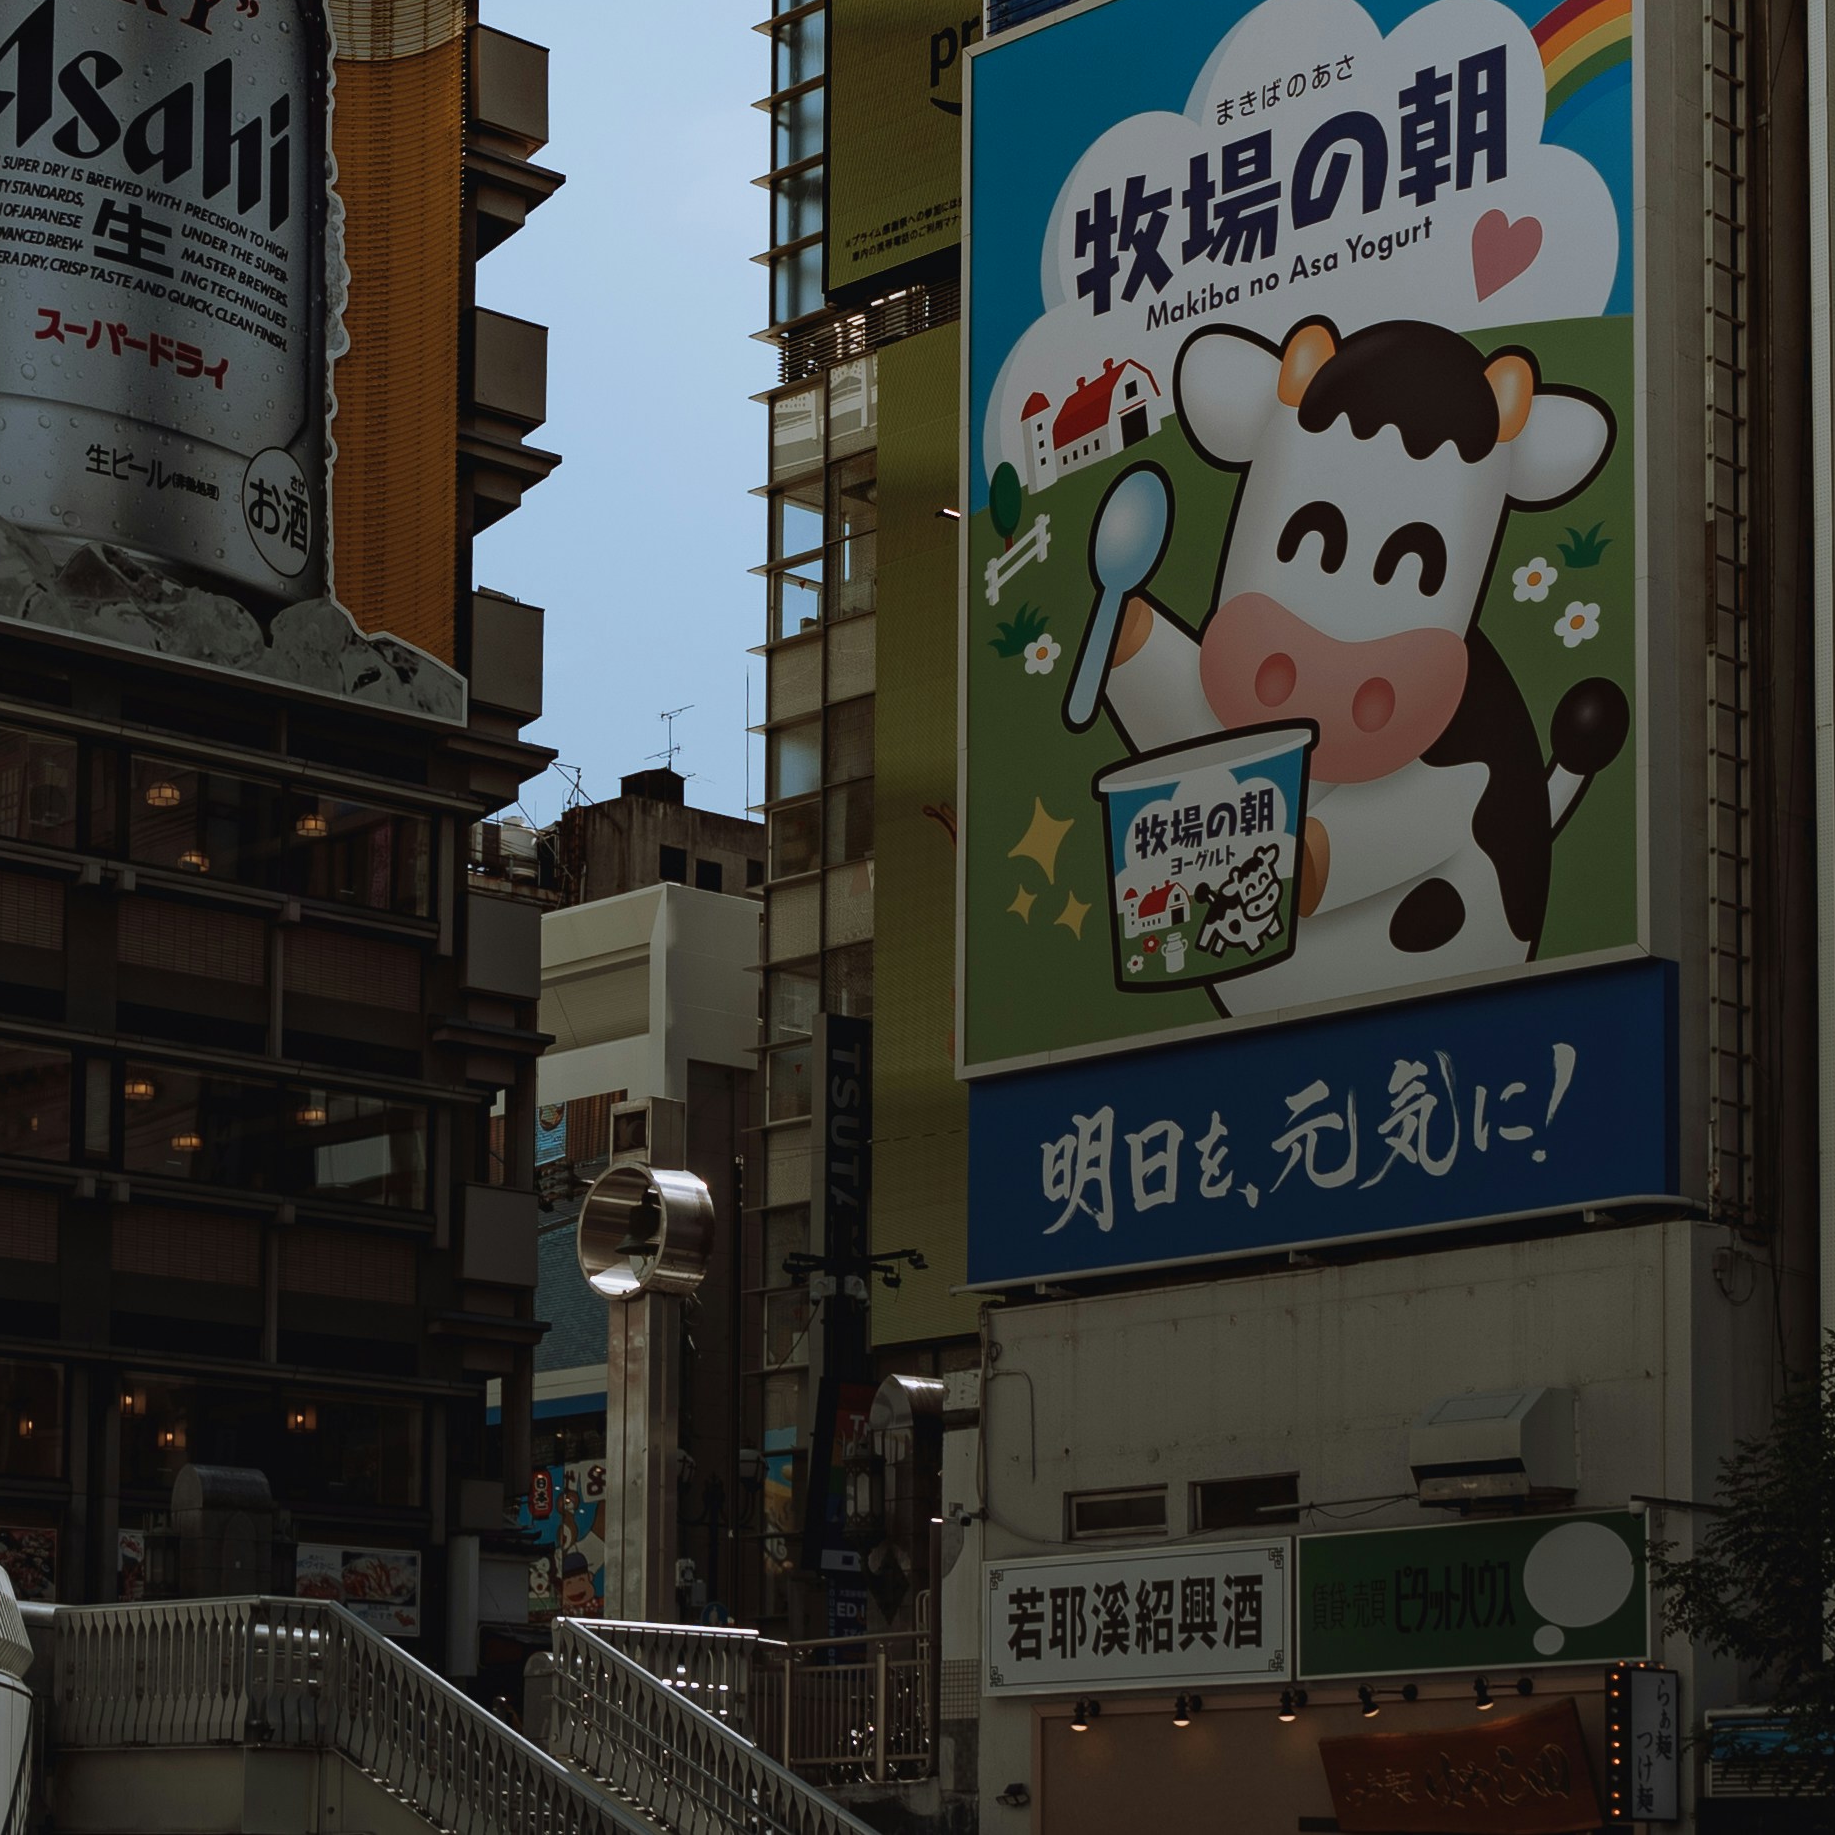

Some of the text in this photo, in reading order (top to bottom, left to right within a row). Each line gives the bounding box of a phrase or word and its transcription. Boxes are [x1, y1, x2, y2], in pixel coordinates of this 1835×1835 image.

[1216, 55, 1356, 126] まきばのあさ
[2, 156, 38, 173] SUPER
[42, 162, 70, 178] DRY
[71, 167, 84, 181] IS
[86, 171, 143, 195] BREWED
[146, 188, 182, 211] WITH
[184, 202, 248, 239] PRECISION
[249, 231, 264, 247] TO
[265, 240, 288, 262] HIGH
[3, 203, 18, 216] OF
[17, 205, 83, 229] JAPANESE
[11, 180, 84, 207] STANDARDS,
[1074, 44, 1508, 315] 牧場の朝
[92, 198, 174, 278] 生
[181, 224, 228, 253] UNDER
[230, 244, 253, 265] THE
[181, 247, 236, 279] MASTER
[1146, 217, 1433, 331] Makiba no Asa Yogurt
[10, 252, 19, 265] A
[21, 253, 48, 271] DRY,
[50, 258, 89, 276] CRISP
[89, 266, 133, 289] TASTE
[133, 279, 165, 298] AND
[215, 307, 253, 333] CLEAN
[180, 270, 287, 328] ING TECHNIQUES
[35, 307, 228, 390] スーパードライ
[248, 478, 308, 555] お酒
[1135, 788, 1273, 859] 牧場の朝
[1171, 845, 1235, 875] ヨーグルト
[830, 1043, 861, 1257] TSUTA
[1007, 1574, 1264, 1663] 若耶溪紹興酒
[1312, 1559, 1516, 1634] 賃貸・売買 ピタットハウス
[1654, 1679, 1674, 1760] らぁ麺
[1635, 1731, 1654, 1814] つけ麺
